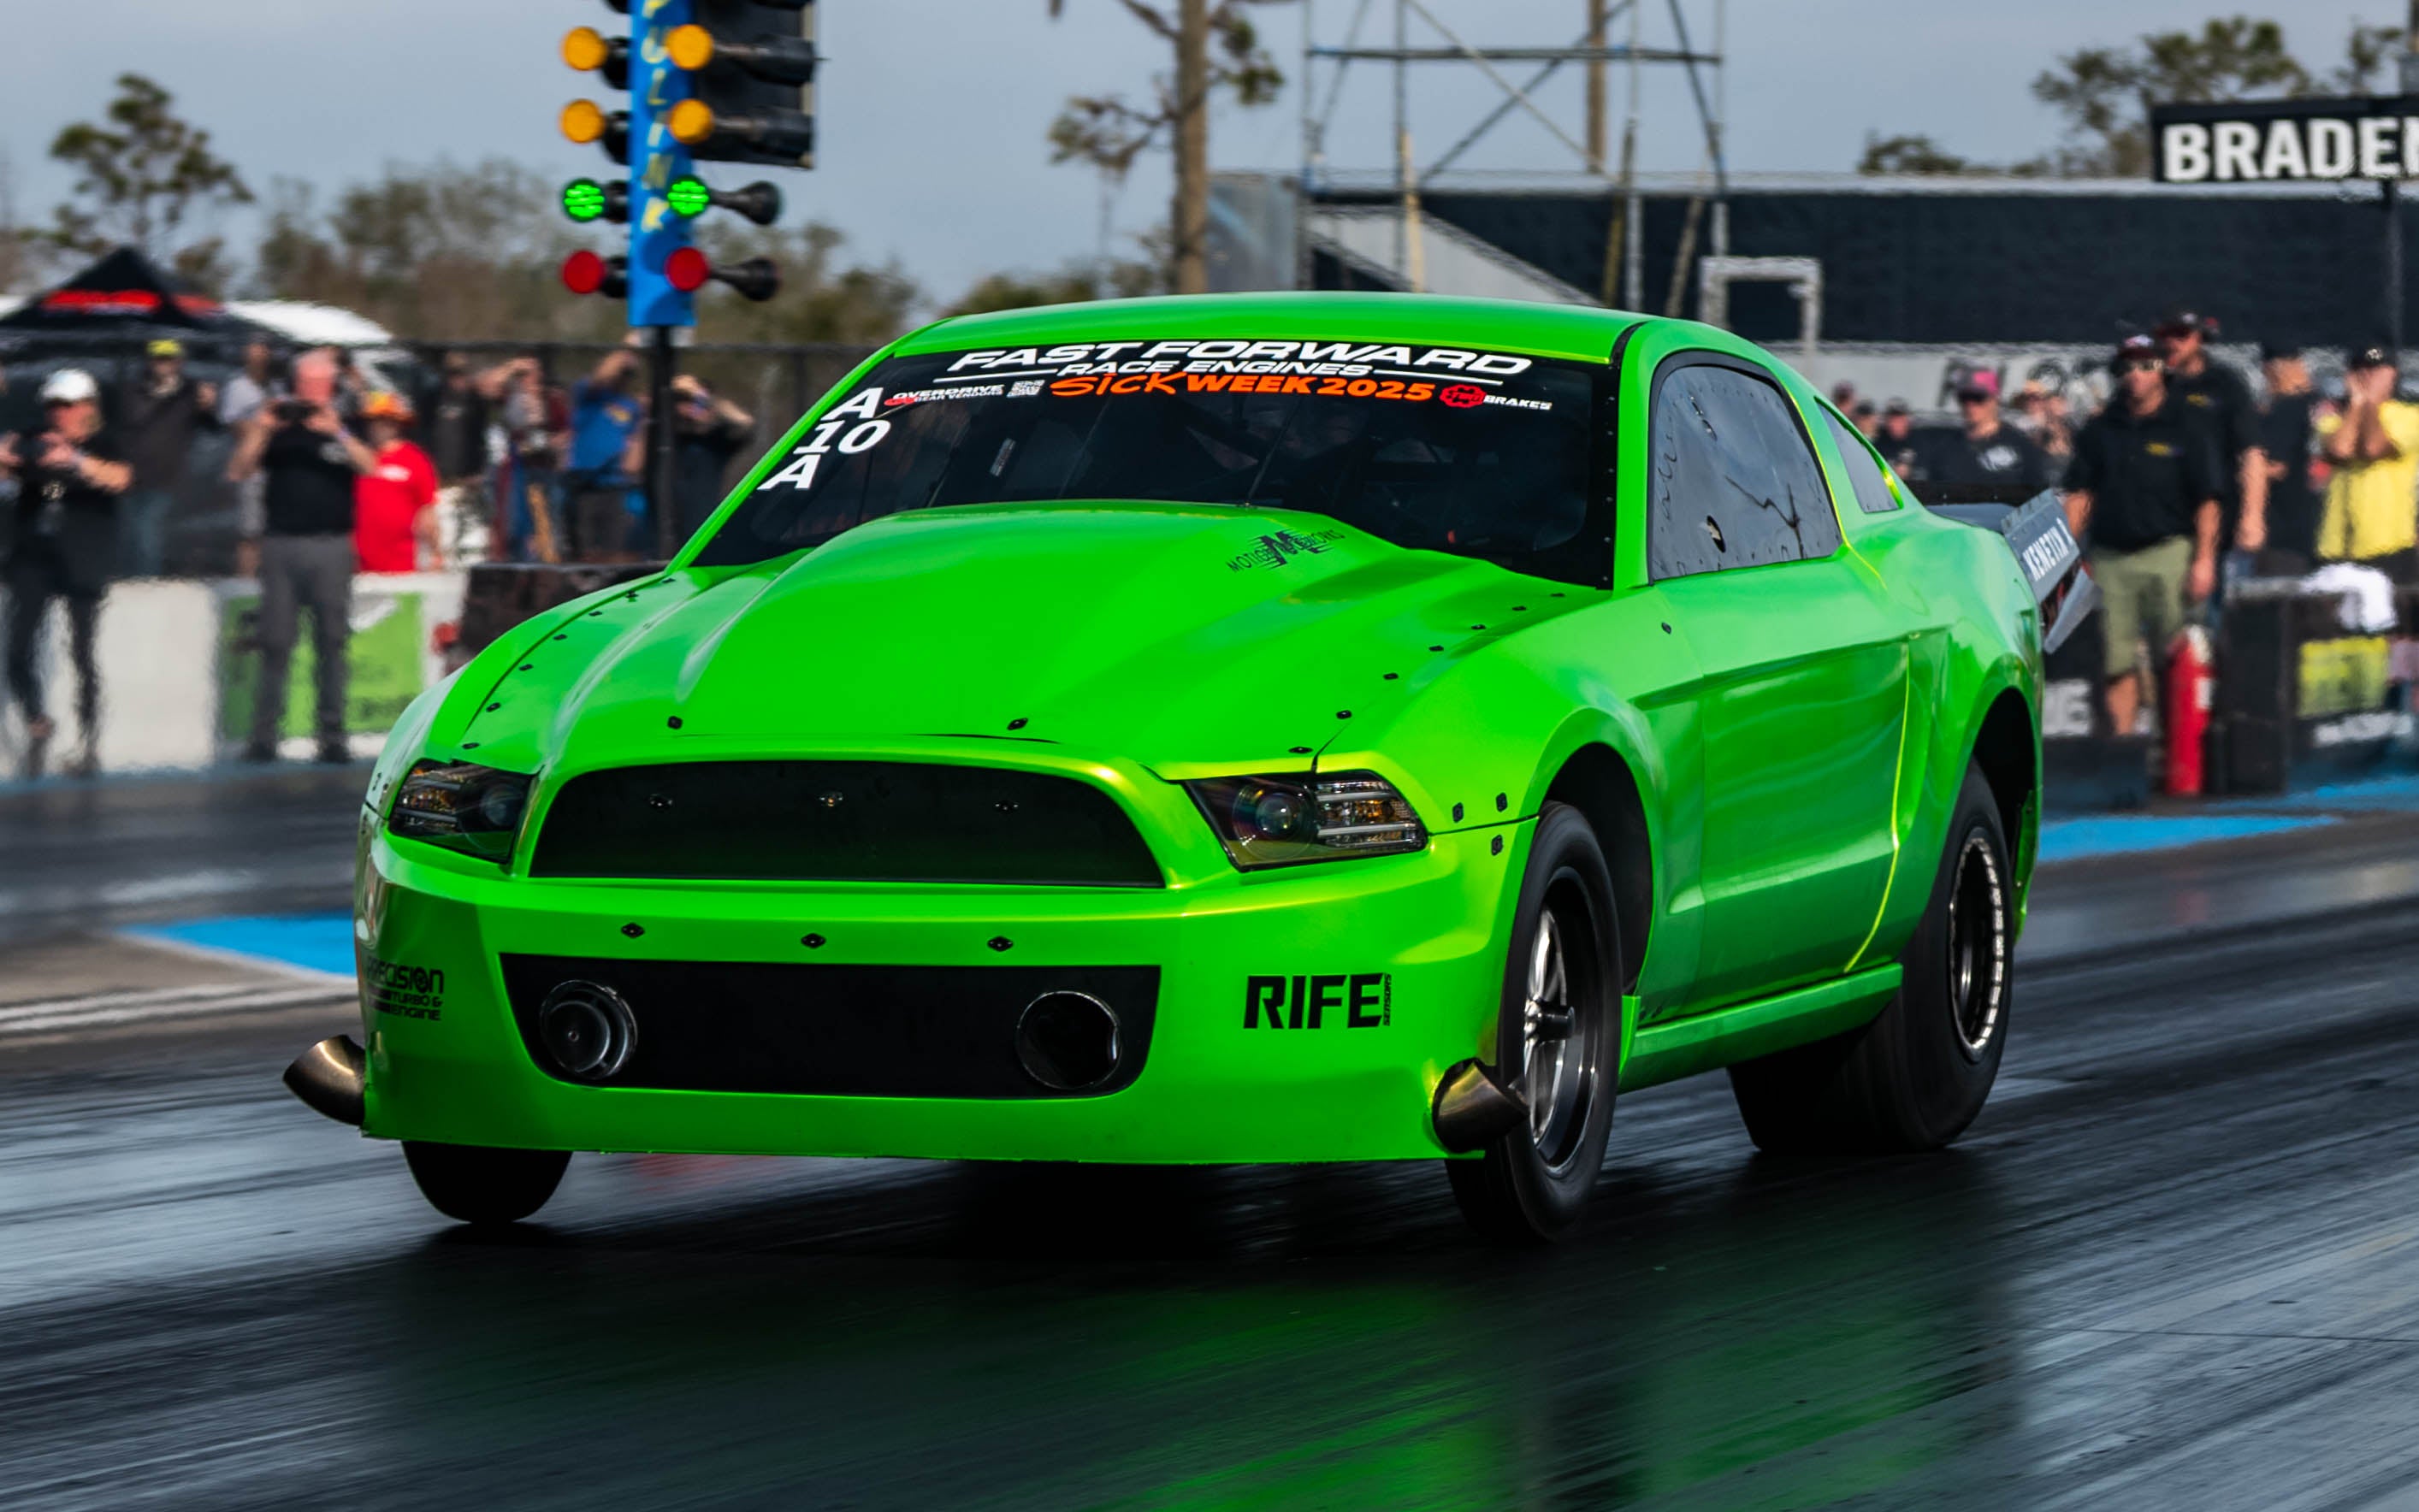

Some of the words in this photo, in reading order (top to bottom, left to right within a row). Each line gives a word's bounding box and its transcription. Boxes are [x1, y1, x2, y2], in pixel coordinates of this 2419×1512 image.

[947, 341, 1144, 372] FAST
[1141, 340, 1533, 375] FORWARD
[1057, 360, 1183, 376] RACE
[1182, 360, 1374, 376] ENGINES
[893, 385, 1004, 399] OVERDRIVE
[1186, 375, 1325, 394] WEEK
[1322, 378, 1437, 401] 2025
[1483, 394, 1553, 411] BRAKES
[819, 387, 884, 422] A
[793, 419, 891, 455] 10
[756, 454, 821, 491] A
[391, 992, 430, 1007] TURBO
[1243, 972, 1384, 1029] RIFE
